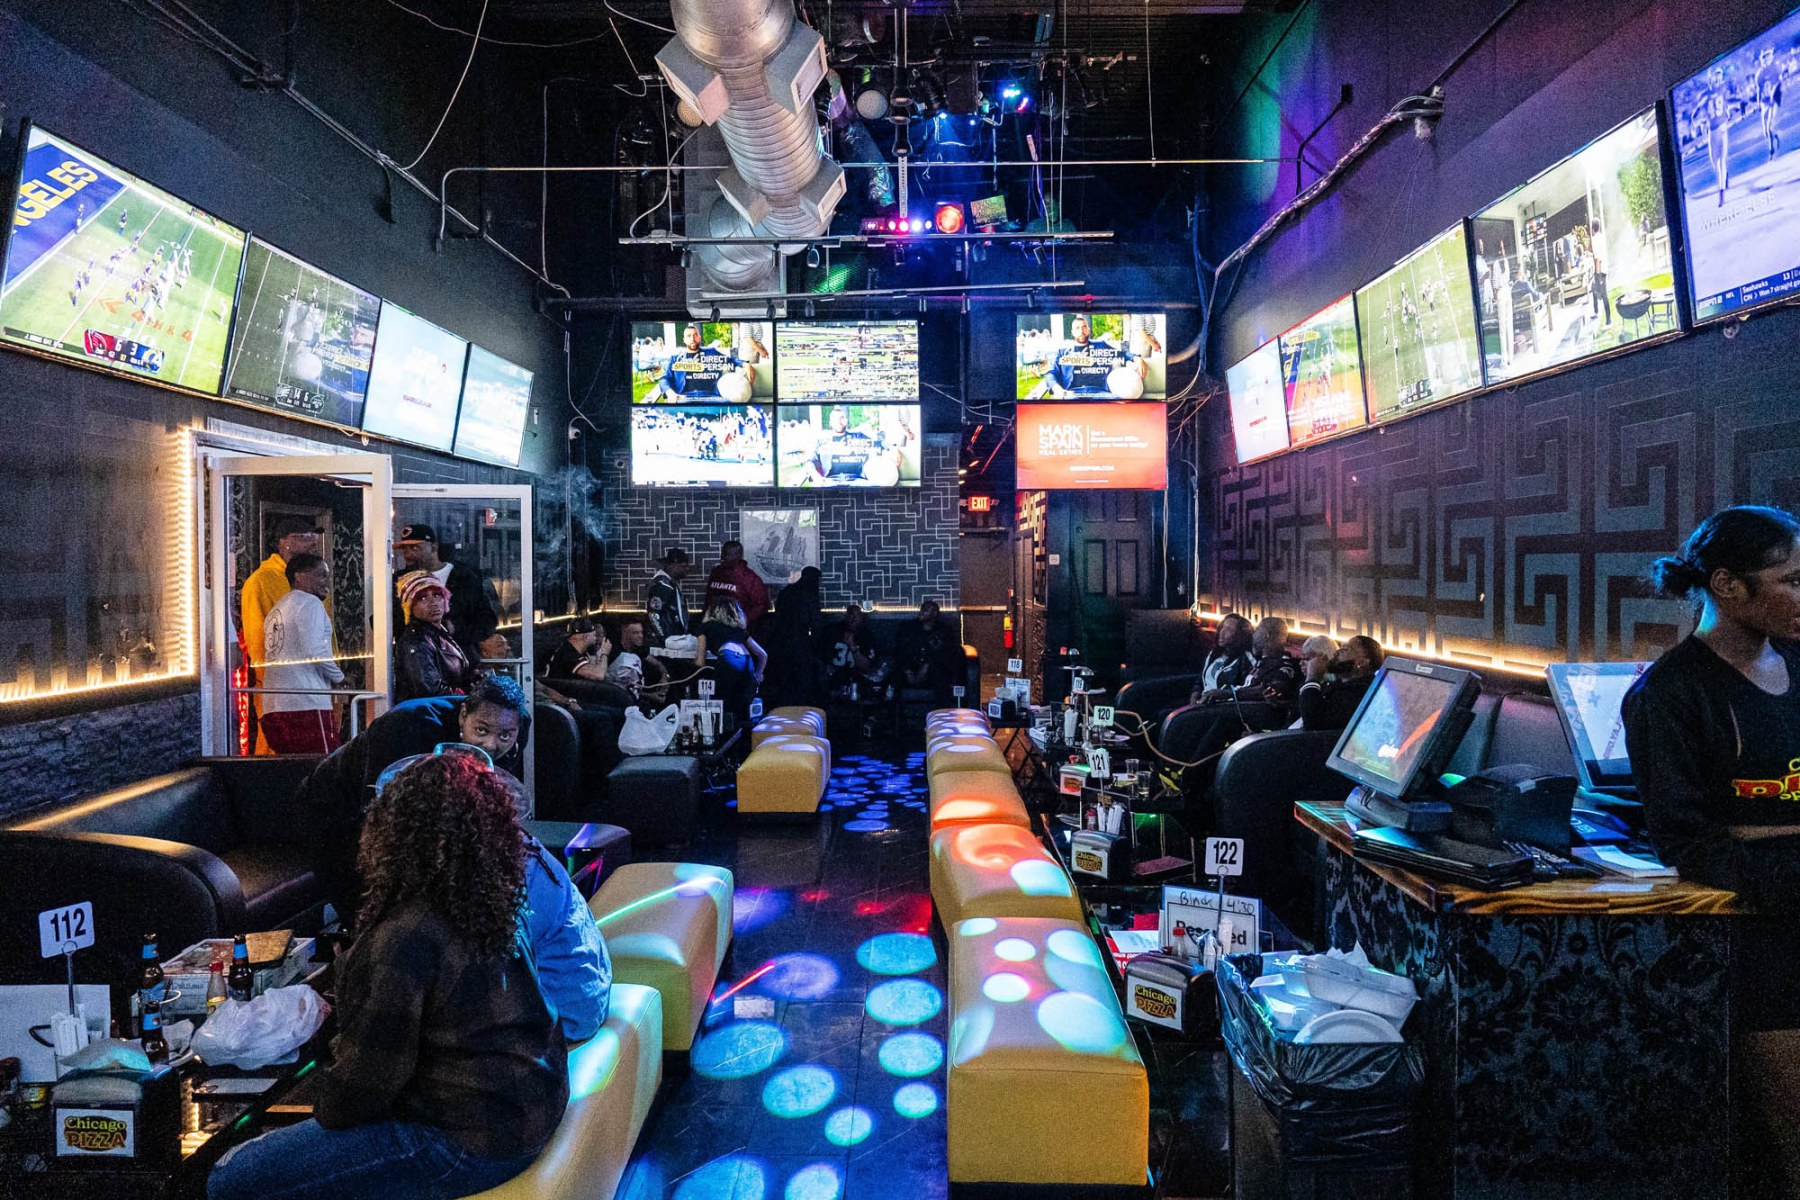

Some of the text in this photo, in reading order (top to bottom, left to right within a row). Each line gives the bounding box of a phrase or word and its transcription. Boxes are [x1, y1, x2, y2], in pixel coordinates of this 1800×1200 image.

[13, 160, 98, 228] GELES
[115, 339, 123, 352] 6
[130, 343, 138, 356] 3
[1090, 348, 1118, 357] DIRECT
[700, 355, 728, 363] DIRECT
[1062, 357, 1090, 365] SPORTS
[1092, 357, 1124, 365] PERSON
[703, 363, 734, 371] PERSON
[1081, 366, 1109, 374] DIRECTV
[1039, 424, 1083, 436] MARK
[1039, 436, 1084, 449] SPAIN
[971, 496, 988, 509] EXIT
[710, 581, 737, 592] ATLANTA
[1010, 660, 1020, 669] 118
[701, 681, 712, 691] 114
[1098, 708, 1111, 720] 120
[1092, 755, 1106, 771] 121
[1213, 841, 1238, 864] 122
[50, 908, 86, 942] 112
[1135, 984, 1177, 1006] Chicago
[1135, 995, 1177, 1019] PIZZA
[64, 1115, 127, 1132] Chicago
[64, 1130, 126, 1149] PIZZA
